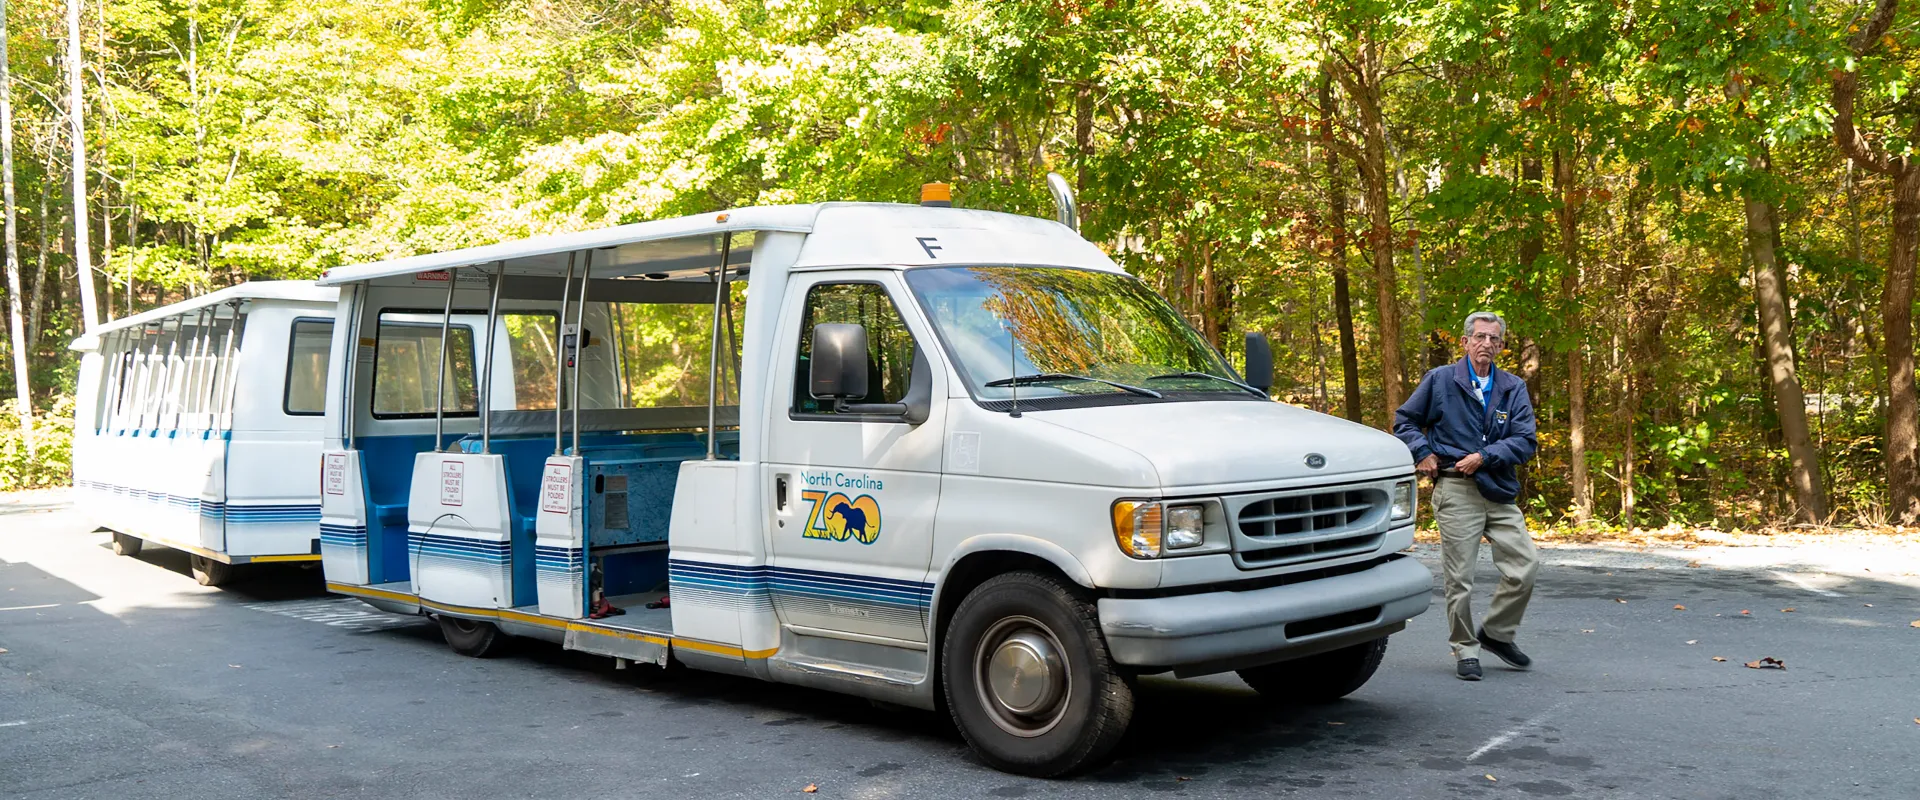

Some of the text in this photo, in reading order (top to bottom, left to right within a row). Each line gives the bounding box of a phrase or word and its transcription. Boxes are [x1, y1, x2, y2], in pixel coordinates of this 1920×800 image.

[915, 237, 942, 259] F
[545, 475, 568, 483] STROLLERS
[801, 470, 883, 490] North Carolina
[801, 490, 882, 545] ZOO
